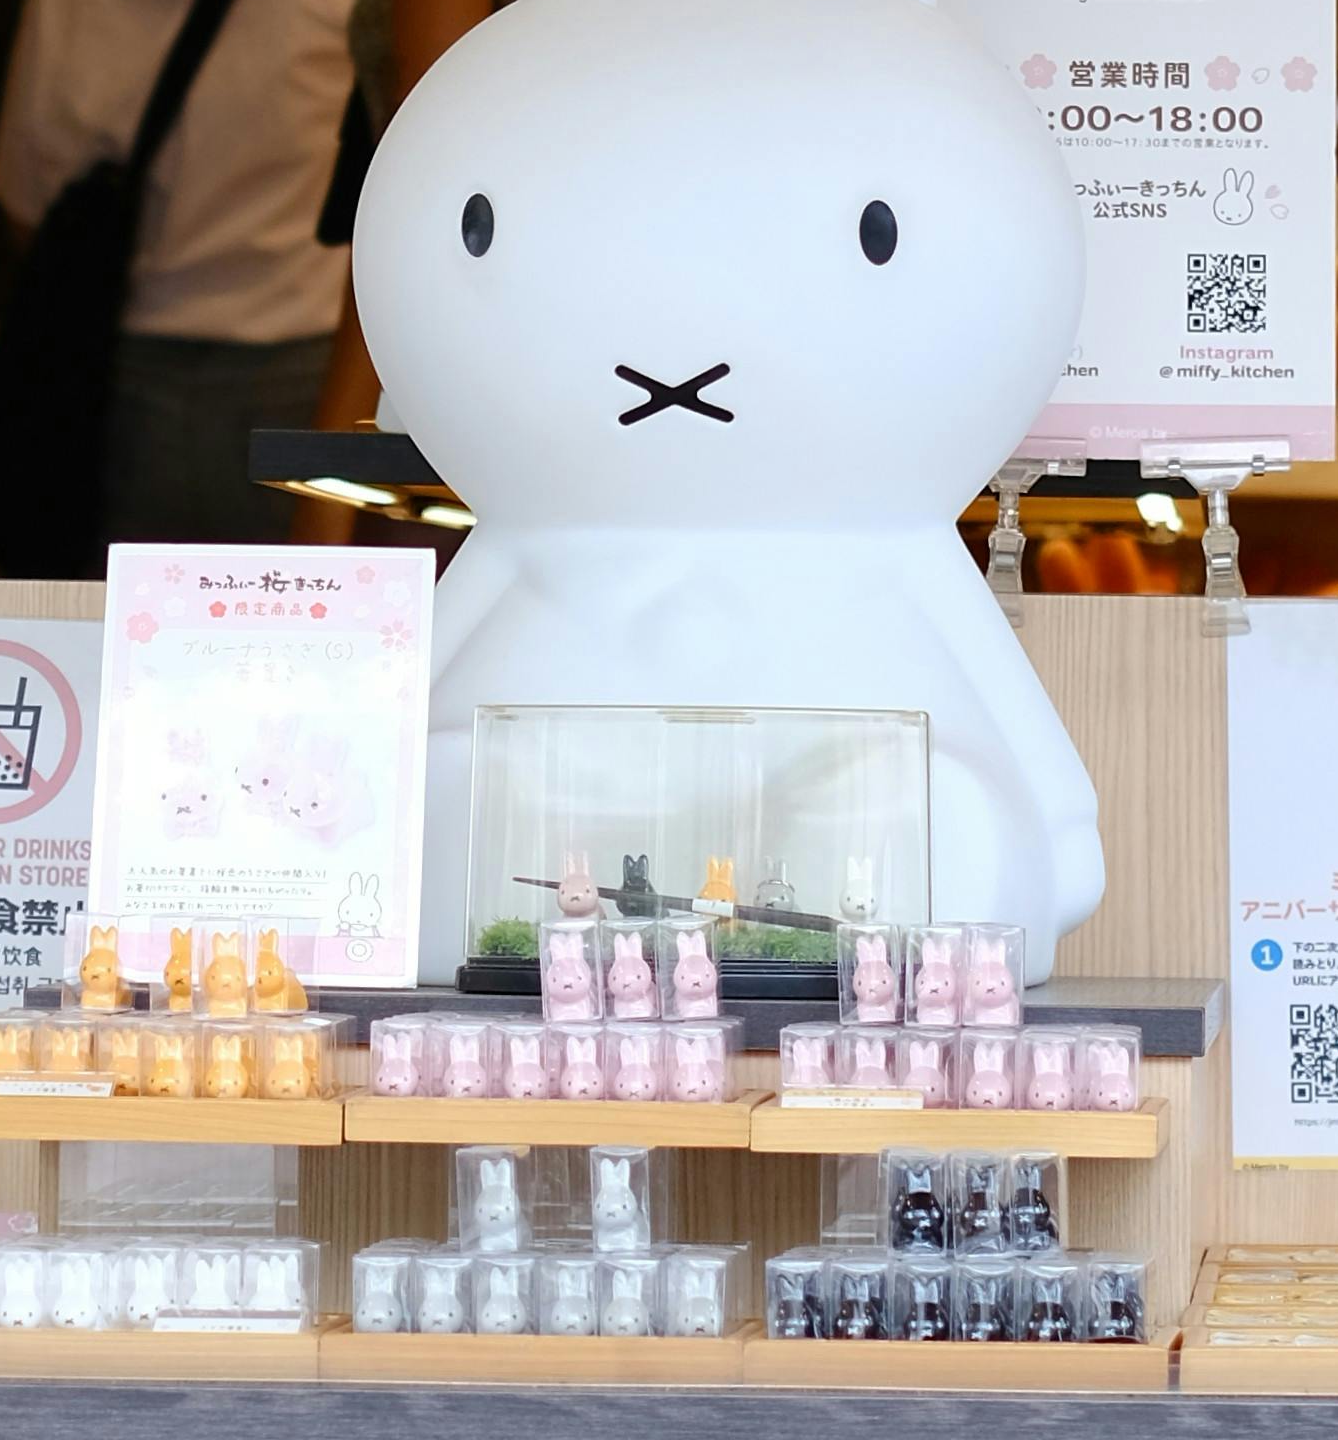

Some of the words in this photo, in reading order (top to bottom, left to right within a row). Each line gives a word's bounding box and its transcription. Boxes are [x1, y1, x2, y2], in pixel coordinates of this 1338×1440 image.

[1069, 61, 1190, 89] 営業時間
[1036, 105, 1263, 132] :00〜18:00
[1074, 180, 1206, 197] っふぃーきっちん
[1093, 203, 1167, 218] 公式SNS
[1180, 345, 1274, 363] Instagram
[235, 601, 303, 617] 限定商品
[14, 838, 91, 861] DRINKS
[19, 865, 89, 887] STORE
